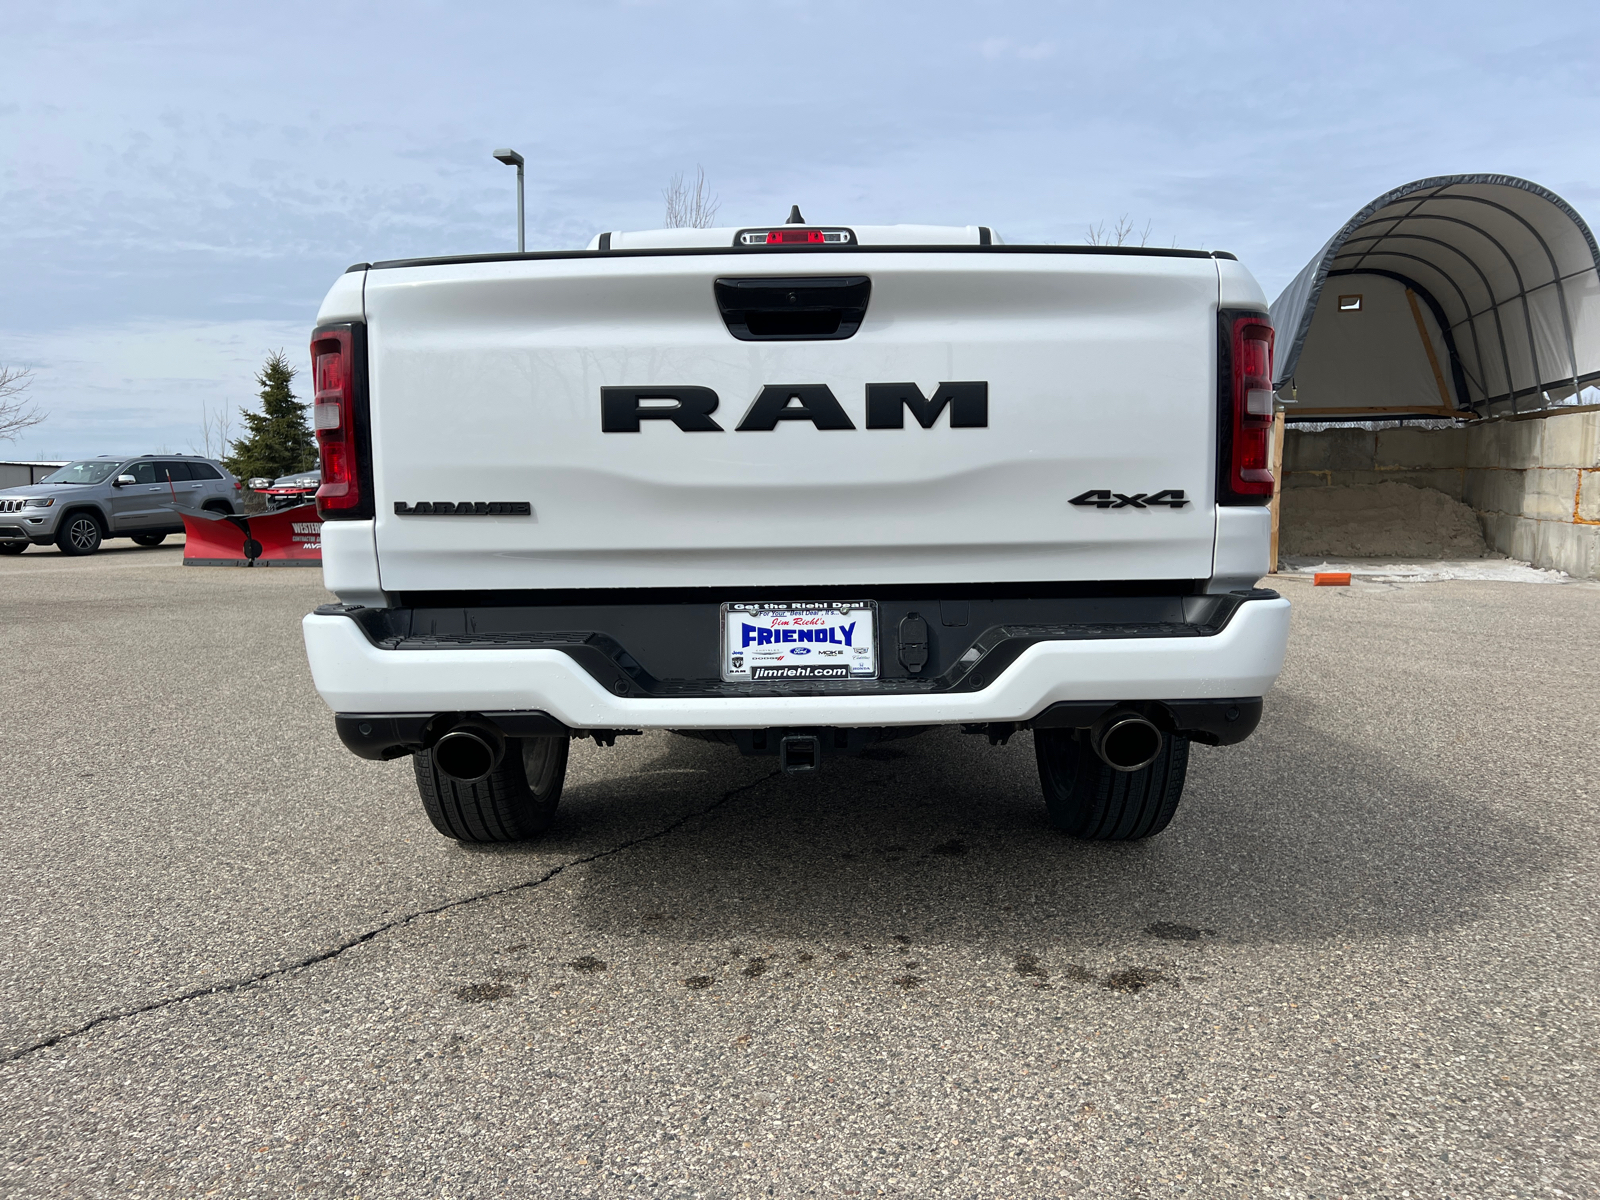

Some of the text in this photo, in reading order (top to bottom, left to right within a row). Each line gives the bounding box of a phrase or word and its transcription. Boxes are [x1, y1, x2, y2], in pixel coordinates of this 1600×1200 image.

[600, 381, 989, 432] RAM
[1067, 489, 1190, 508] 4x4
[394, 502, 531, 515] LARAMIE
[770, 617, 825, 628] Jim Riehl's
[742, 621, 857, 648] FRIENDLY
[754, 667, 846, 679] jimriehl.com
